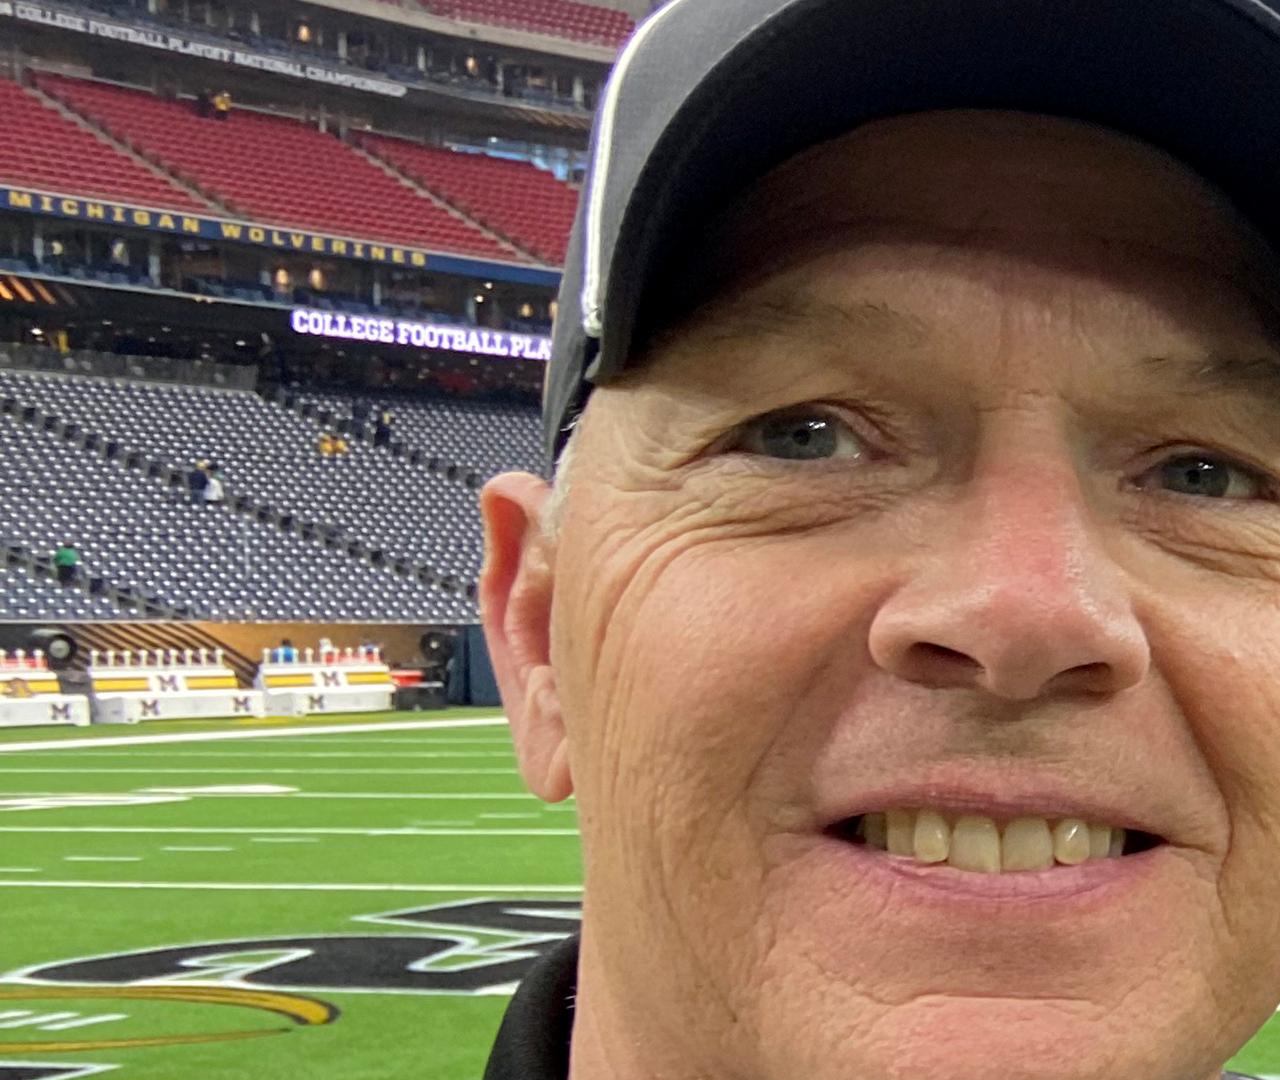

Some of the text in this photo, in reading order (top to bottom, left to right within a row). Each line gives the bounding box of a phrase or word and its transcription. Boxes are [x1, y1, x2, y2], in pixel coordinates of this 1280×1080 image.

[16, 5, 87, 30] COLLEGE
[89, 20, 167, 49] FOOTBALL
[8, 191, 426, 267] MICHIGAN WOLVERINES
[291, 309, 552, 361] COLLEGE FOOTBALL PLA
